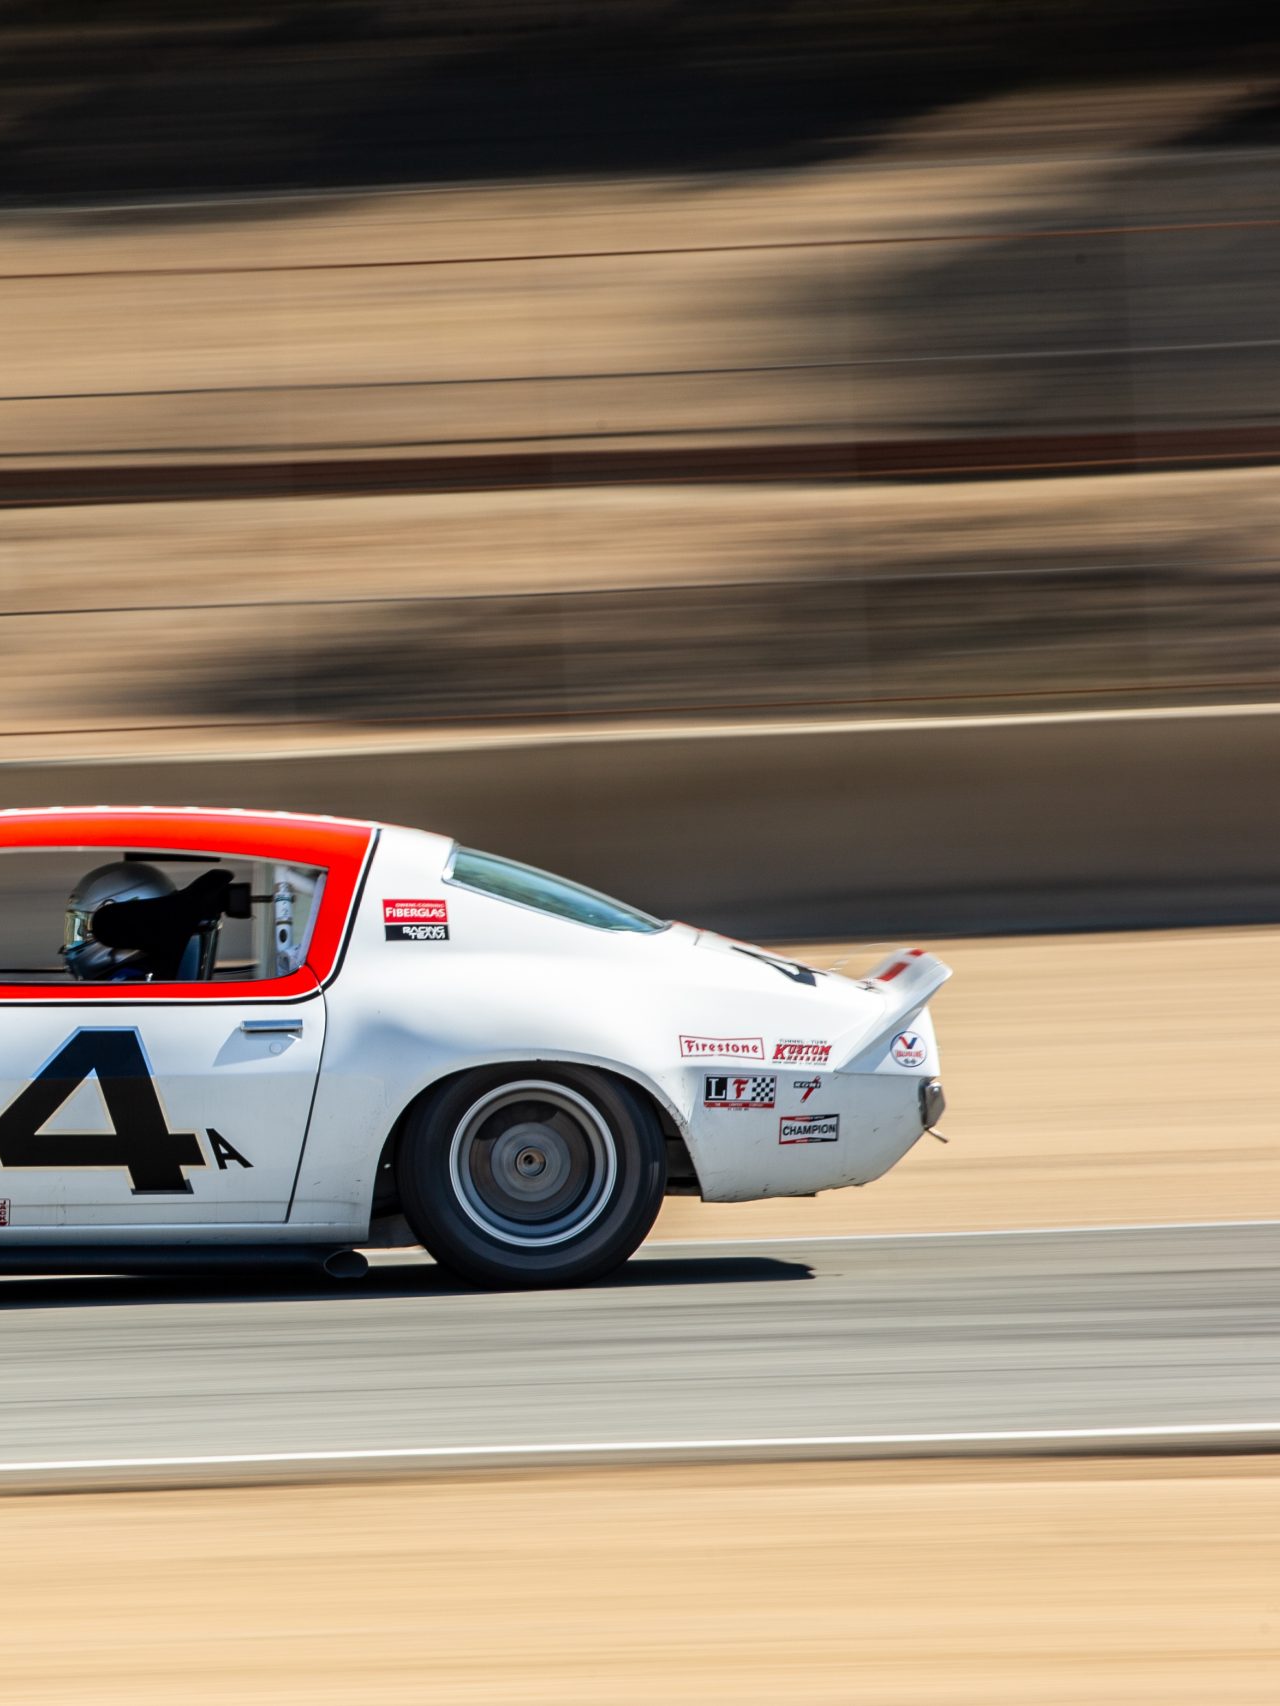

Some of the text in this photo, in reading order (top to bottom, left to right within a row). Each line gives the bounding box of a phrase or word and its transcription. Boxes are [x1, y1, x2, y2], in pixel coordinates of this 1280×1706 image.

[385, 907, 446, 918] FIBERGLAS
[402, 926, 445, 934] RACING
[409, 932, 446, 940] TEAM
[684, 1039, 759, 1053] Firestone
[772, 1044, 832, 1060] KUSTOM
[782, 1123, 837, 1136] CHAMPION
[205, 1127, 255, 1170] A
